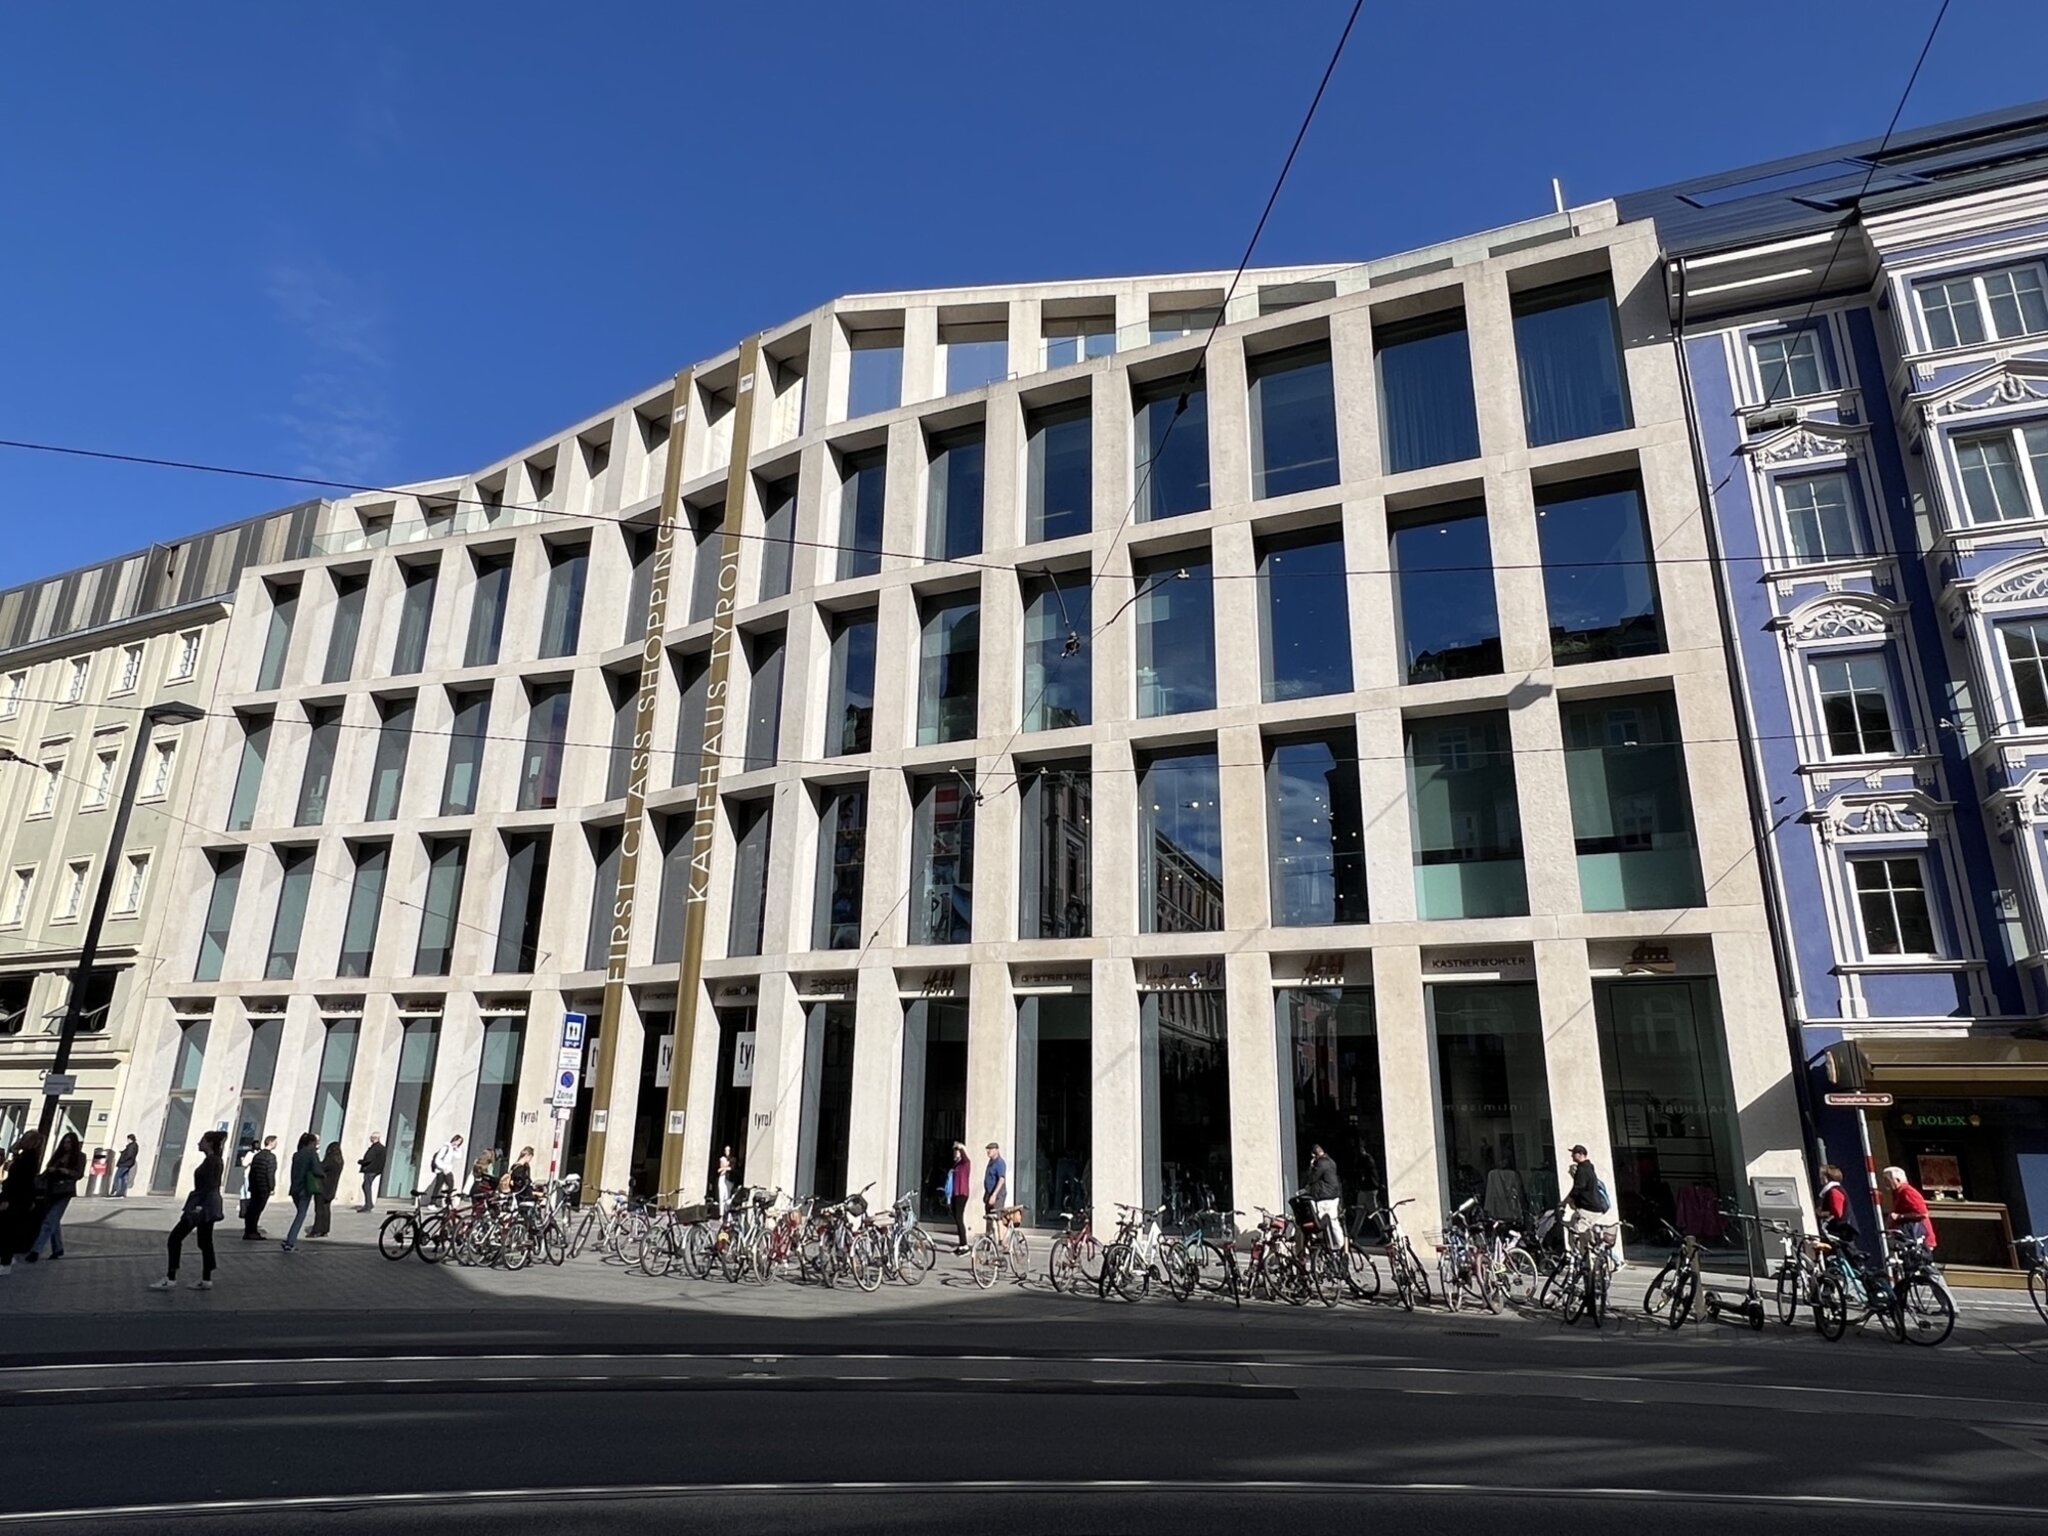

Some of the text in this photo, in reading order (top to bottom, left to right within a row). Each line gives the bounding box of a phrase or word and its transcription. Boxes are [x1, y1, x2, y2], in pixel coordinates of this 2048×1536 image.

[607, 880, 635, 983] FIRST
[638, 516, 676, 713] SHOPPING
[687, 680, 728, 903] KAUFHAUS
[520, 1110, 539, 1125] tyrol
[754, 1110, 772, 1130] tyrol
[1917, 1115, 1967, 1125] ROLEX
